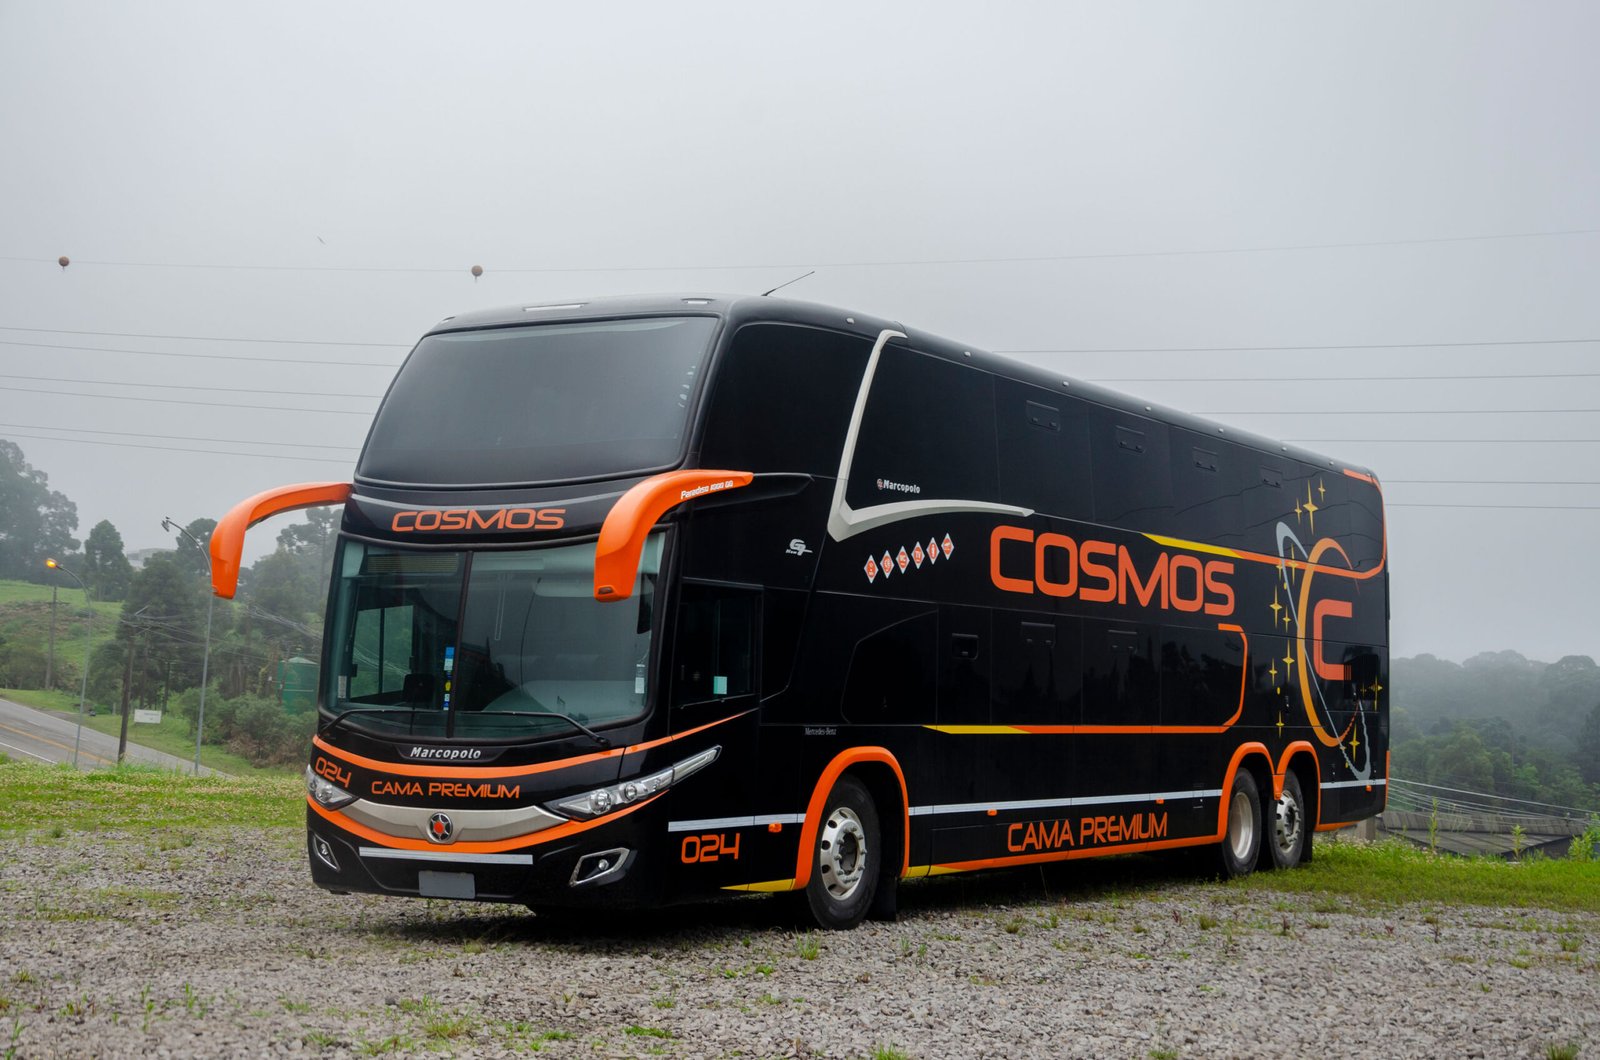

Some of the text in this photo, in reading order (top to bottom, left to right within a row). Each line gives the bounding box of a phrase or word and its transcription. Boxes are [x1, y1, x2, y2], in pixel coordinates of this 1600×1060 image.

[883, 479, 921, 494] Marcopolo
[391, 508, 566, 533] COSMOS
[989, 524, 1236, 617] COSMOS
[1313, 598, 1353, 681] C
[410, 746, 482, 760] Marcopolo
[314, 756, 352, 788] 024
[371, 780, 521, 799] CAMA PREMIUM
[680, 832, 741, 864] 024
[1007, 811, 1168, 853] CAMA PREMIUM
